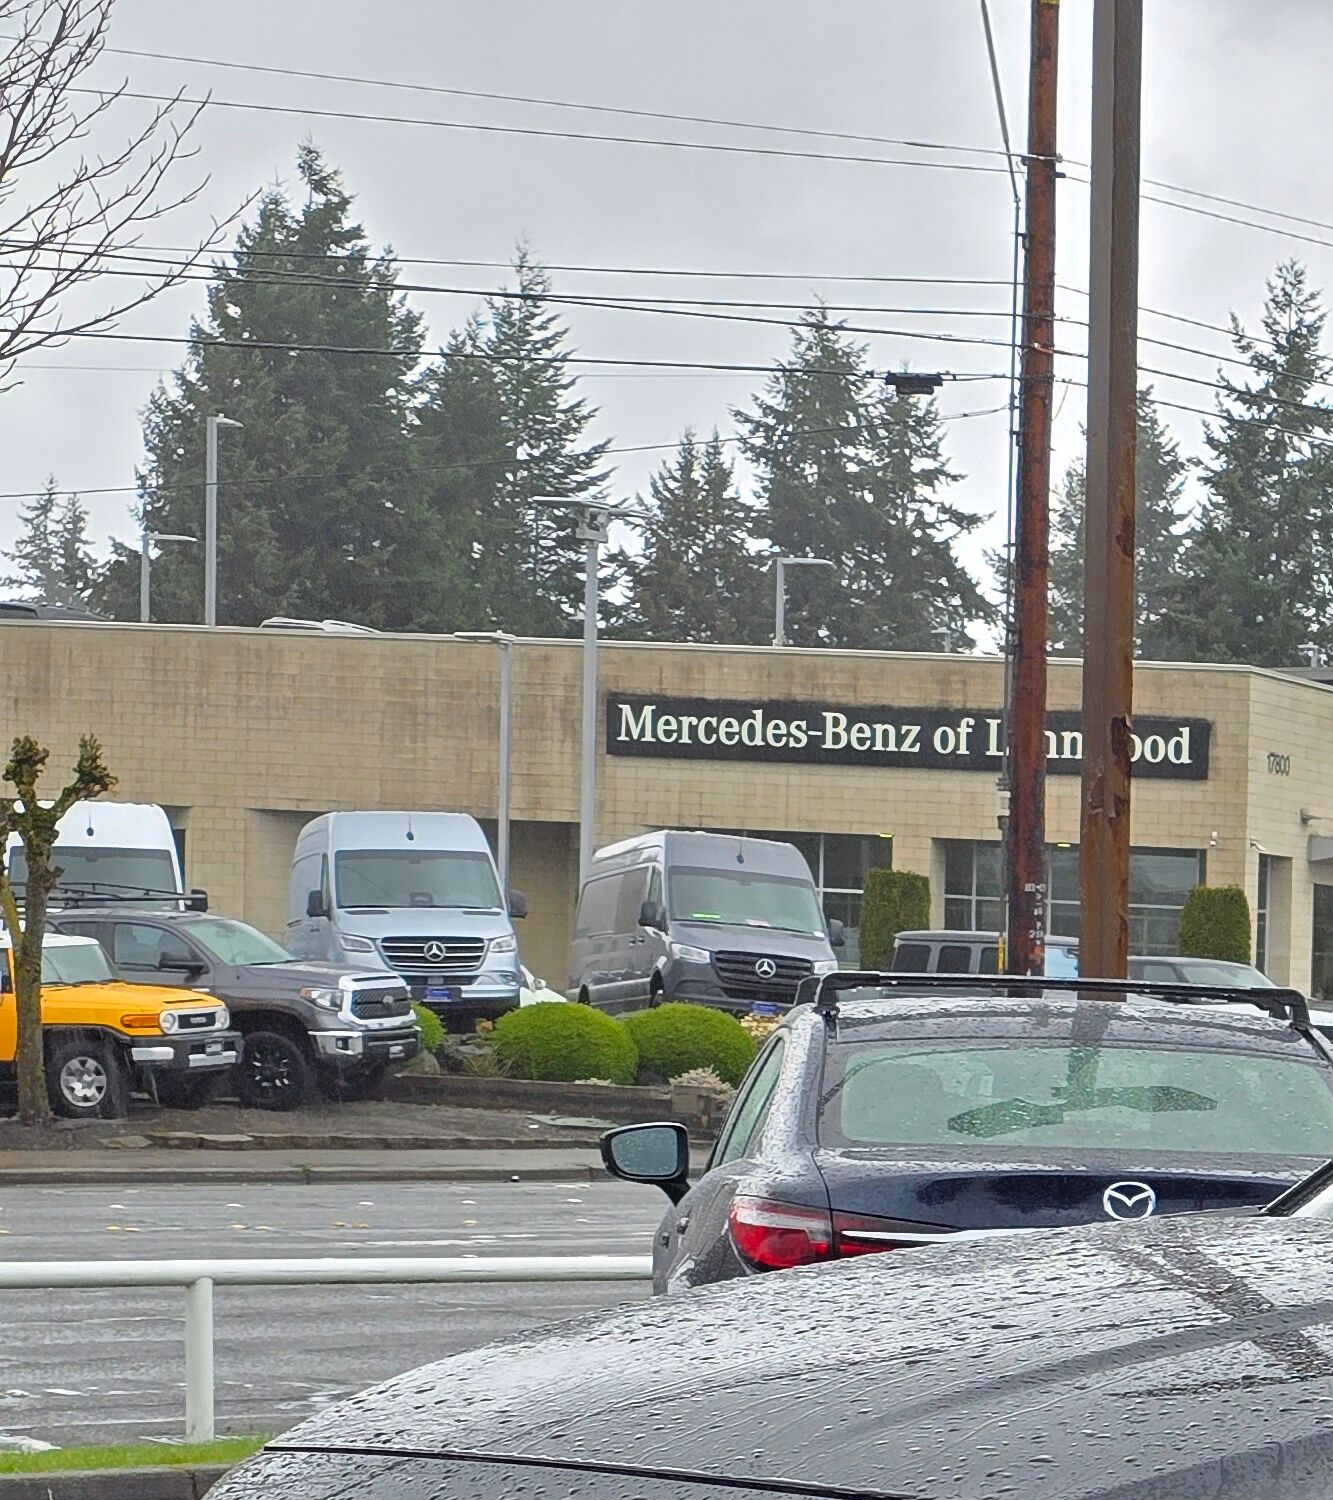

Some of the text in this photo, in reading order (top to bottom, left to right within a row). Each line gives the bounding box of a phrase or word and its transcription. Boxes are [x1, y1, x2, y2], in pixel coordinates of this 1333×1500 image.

[617, 704, 1193, 764] Mercedes-Benz of Lnnood
